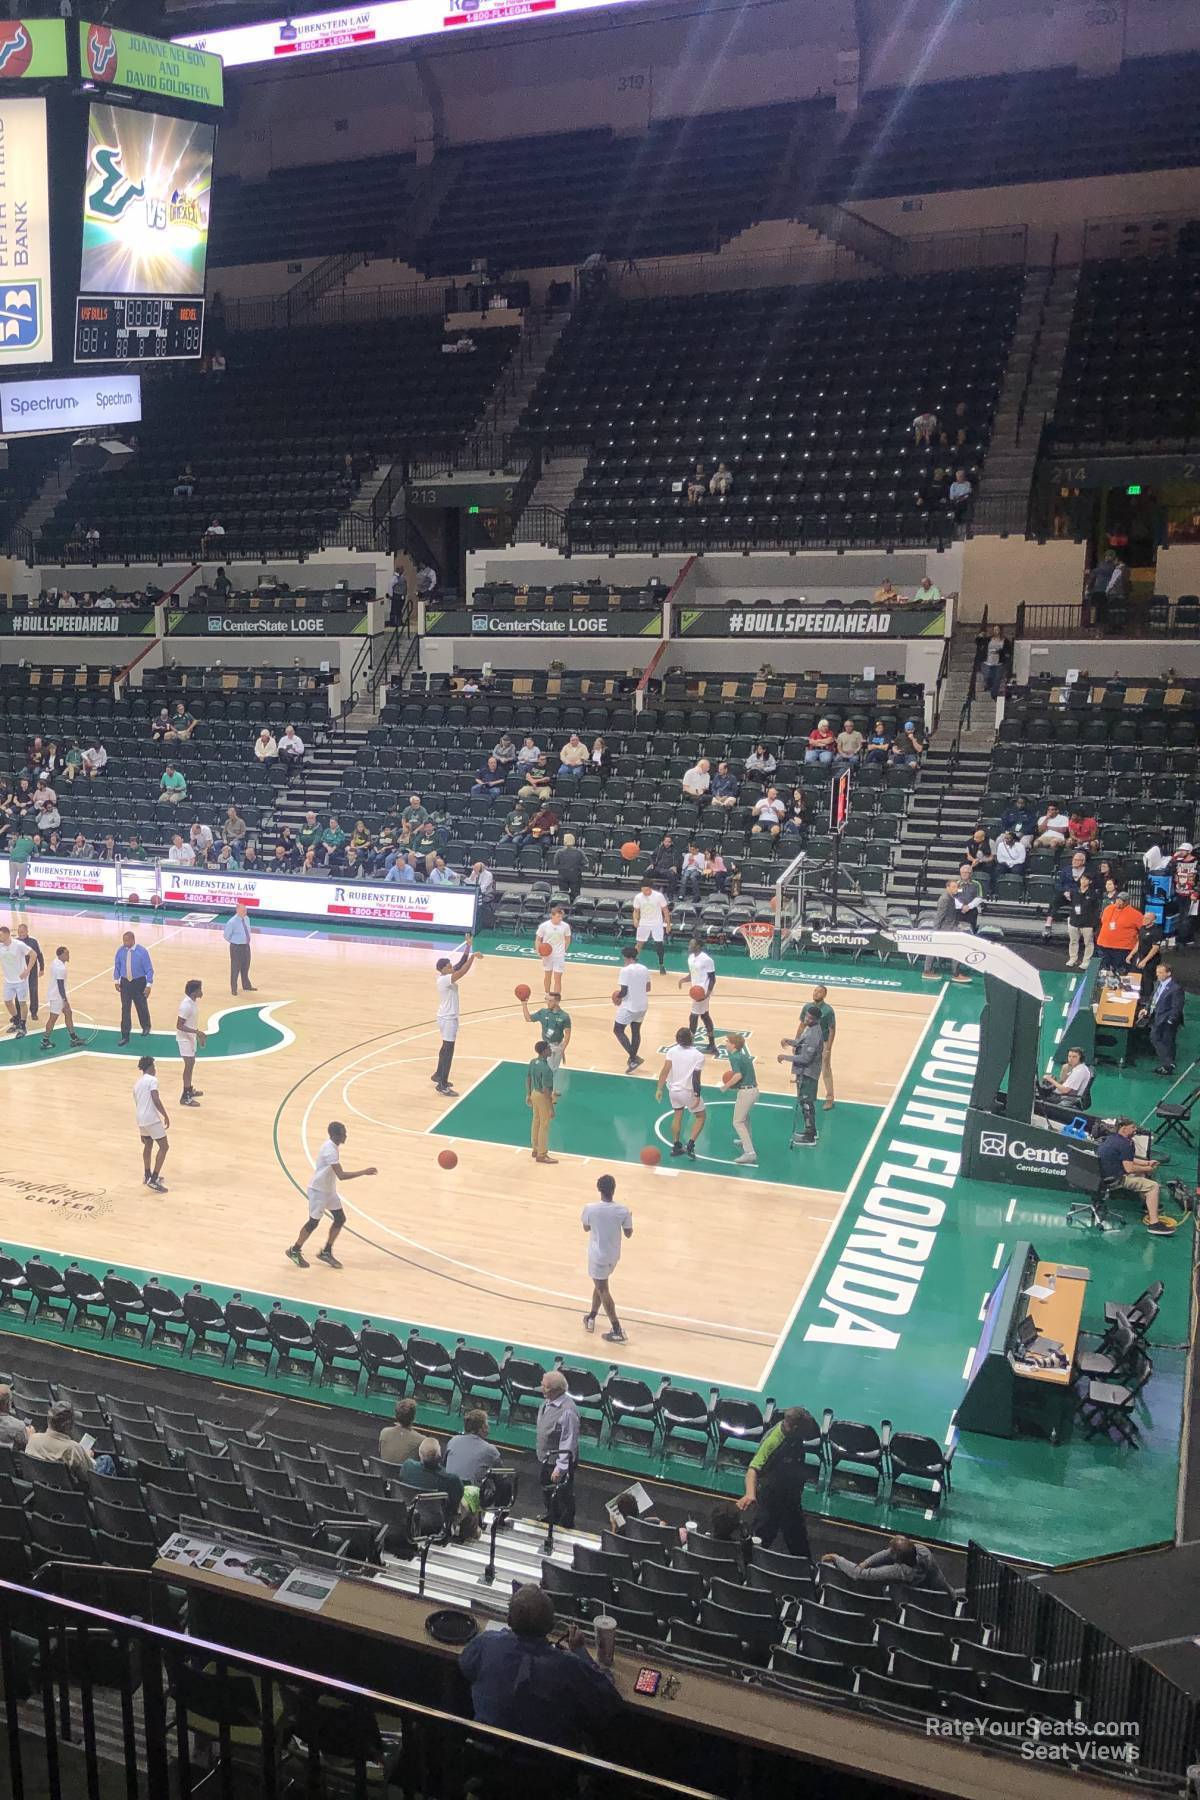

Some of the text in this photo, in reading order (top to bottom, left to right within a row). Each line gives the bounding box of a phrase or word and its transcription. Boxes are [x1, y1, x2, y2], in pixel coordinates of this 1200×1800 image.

[298, 12, 370, 34] UBENSTEIN LAW
[294, 35, 354, 51] 1-800-FL-LEGAL
[128, 37, 206, 68] JOANNE NELSON
[159, 61, 180, 77] AND
[126, 70, 210, 100] DAVID GOLDSTEIN
[146, 198, 167, 230] VS
[14, 200, 29, 266] BANK
[10, 396, 76, 415] Spectrum
[96, 392, 133, 409] Spectrum
[411, 490, 436, 504] 213
[12, 615, 119, 632] #BULLSPEEDAHEAD
[222, 618, 325, 632] CenterState LOGE
[489, 618, 608, 632] CenterState LOGE
[729, 613, 891, 633] #BULLSPEEDAHEAD
[34, 866, 81, 877] RUBENSTEIN
[83, 869, 101, 878] LAW
[35, 881, 85, 890] 1-800-FL-LEGAL
[184, 879, 235, 890] RUBENSTEIN
[238, 882, 256, 891] LAW
[184, 893, 239, 904] 1-800-FL-LEGAL
[348, 892, 404, 903] RUBENSTEIN
[408, 896, 430, 904] LAW
[349, 908, 411, 919] 1-800-FL-LEGAL
[811, 932, 863, 945] Spectrum
[893, 933, 933, 943] SPALDING
[787, 971, 902, 986] CenterState
[25, 1194, 95, 1212] CENTER
[803, 1139, 964, 1350] FLORIDA
